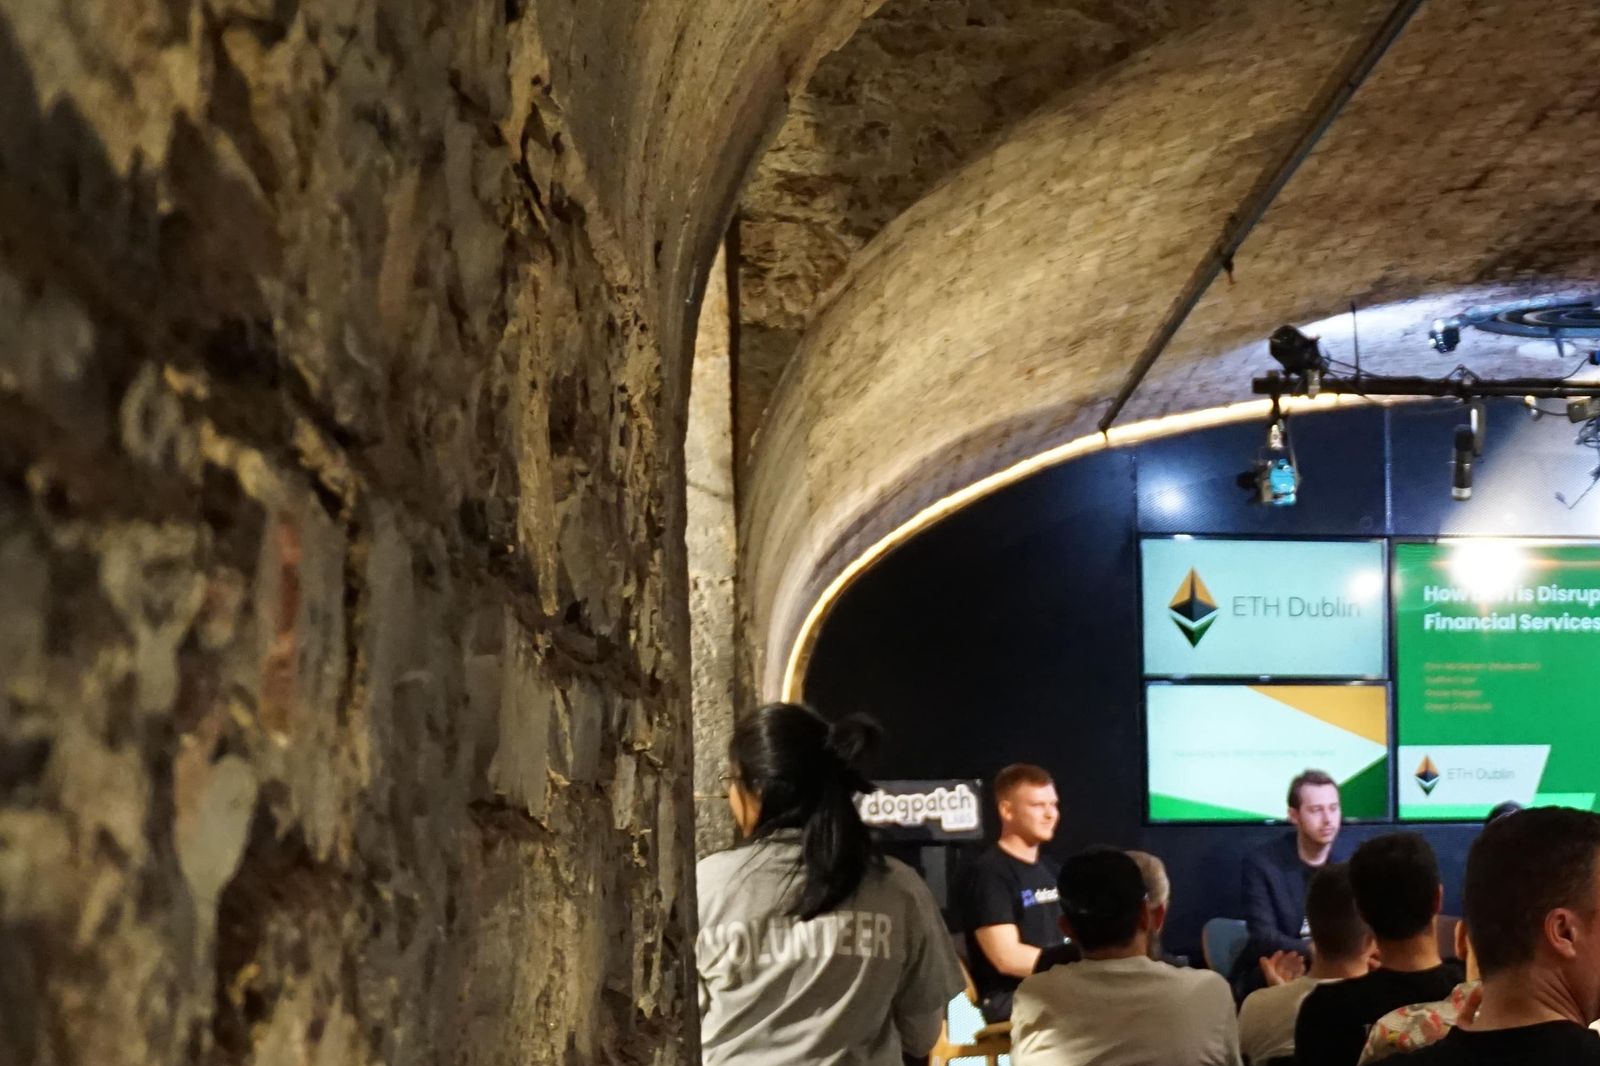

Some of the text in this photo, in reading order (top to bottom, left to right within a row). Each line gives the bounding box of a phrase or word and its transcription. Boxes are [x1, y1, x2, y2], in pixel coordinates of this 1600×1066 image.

[1424, 585, 1466, 602] How
[1232, 596, 1362, 617] ETH Dublin
[1424, 612, 1516, 632] Financial
[1447, 768, 1473, 780] ETH
[868, 788, 971, 821] dogpatch
[701, 911, 891, 965] VOLUNTEER
